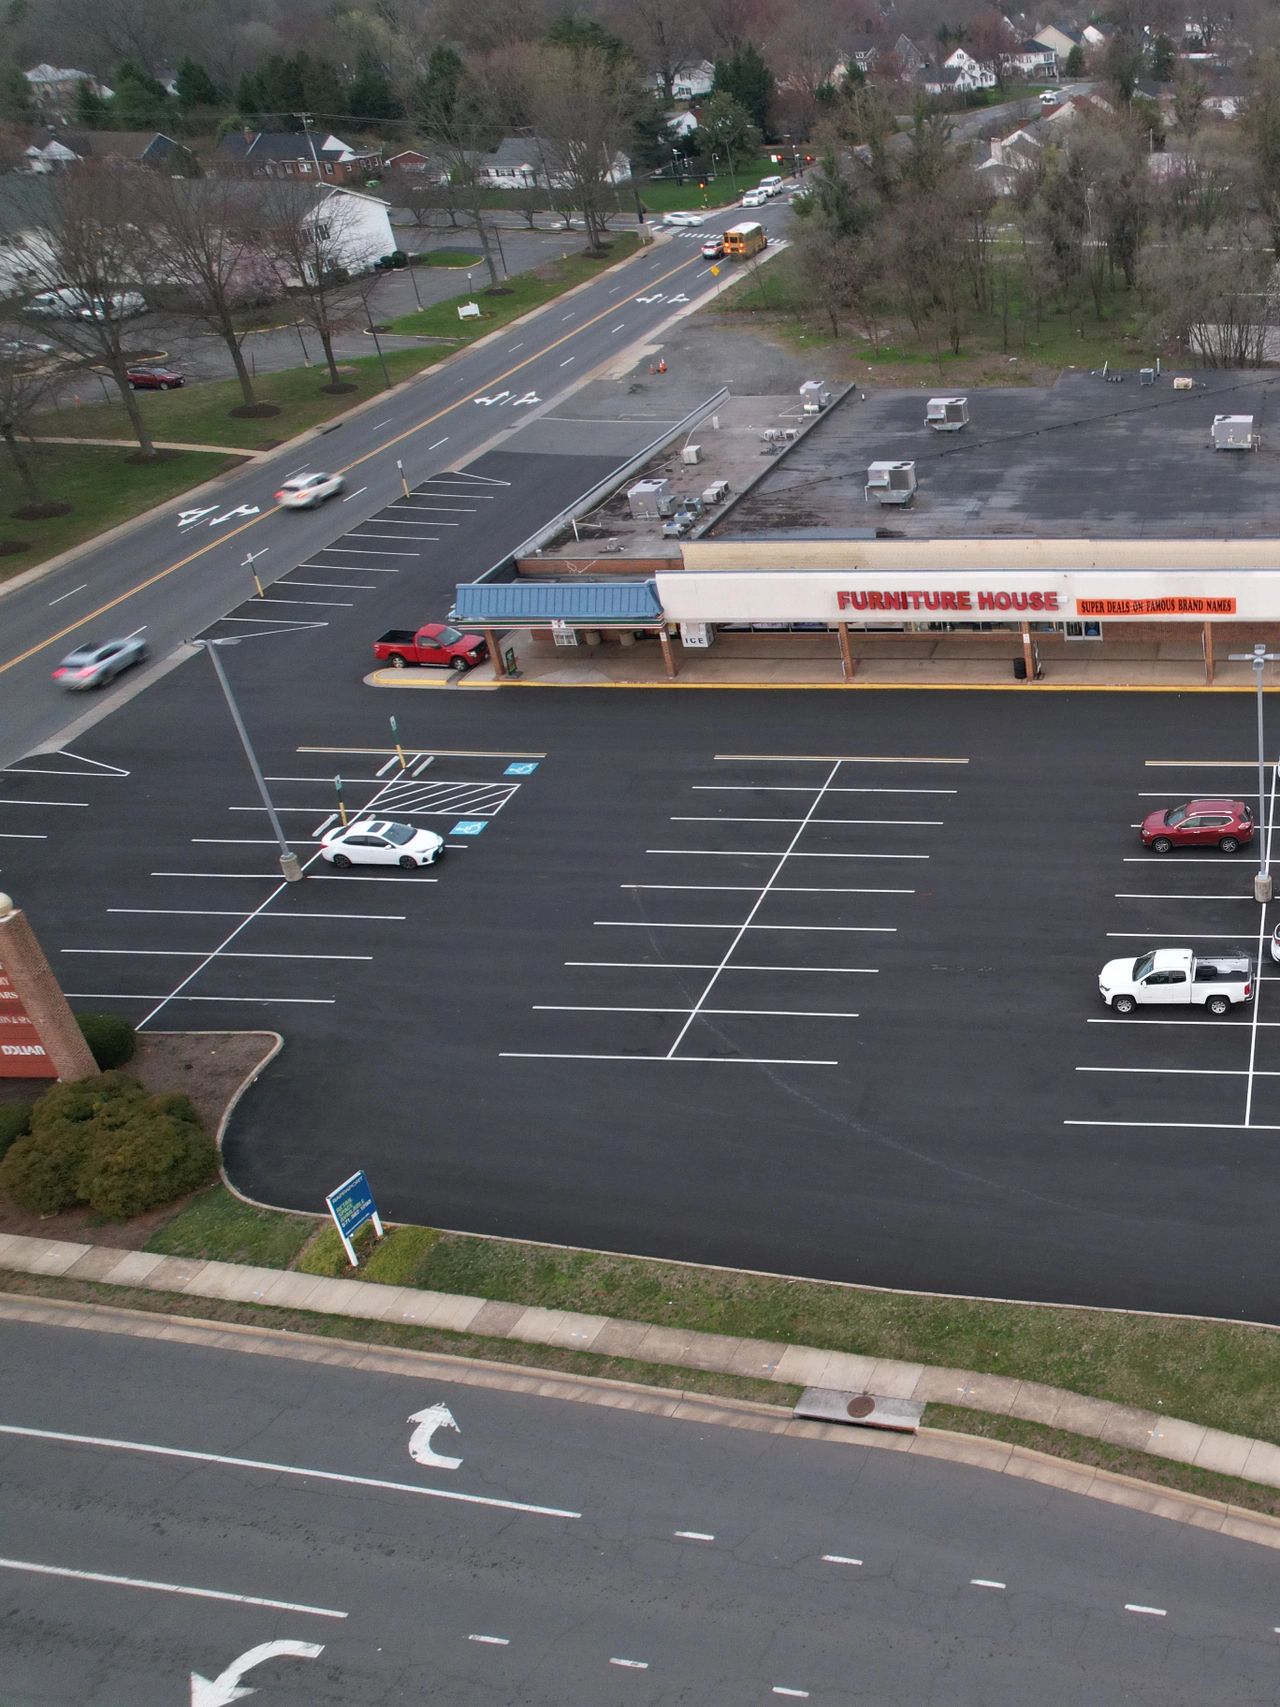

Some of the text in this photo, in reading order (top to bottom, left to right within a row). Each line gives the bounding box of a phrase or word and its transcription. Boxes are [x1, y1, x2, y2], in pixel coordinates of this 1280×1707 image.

[836, 591, 1059, 611] FURNITURE HOUSE
[1081, 599, 1232, 613] SUPER DEALS ON FAMOUS BRAND NAMES
[2, 1045, 46, 1056] DOLLAR
